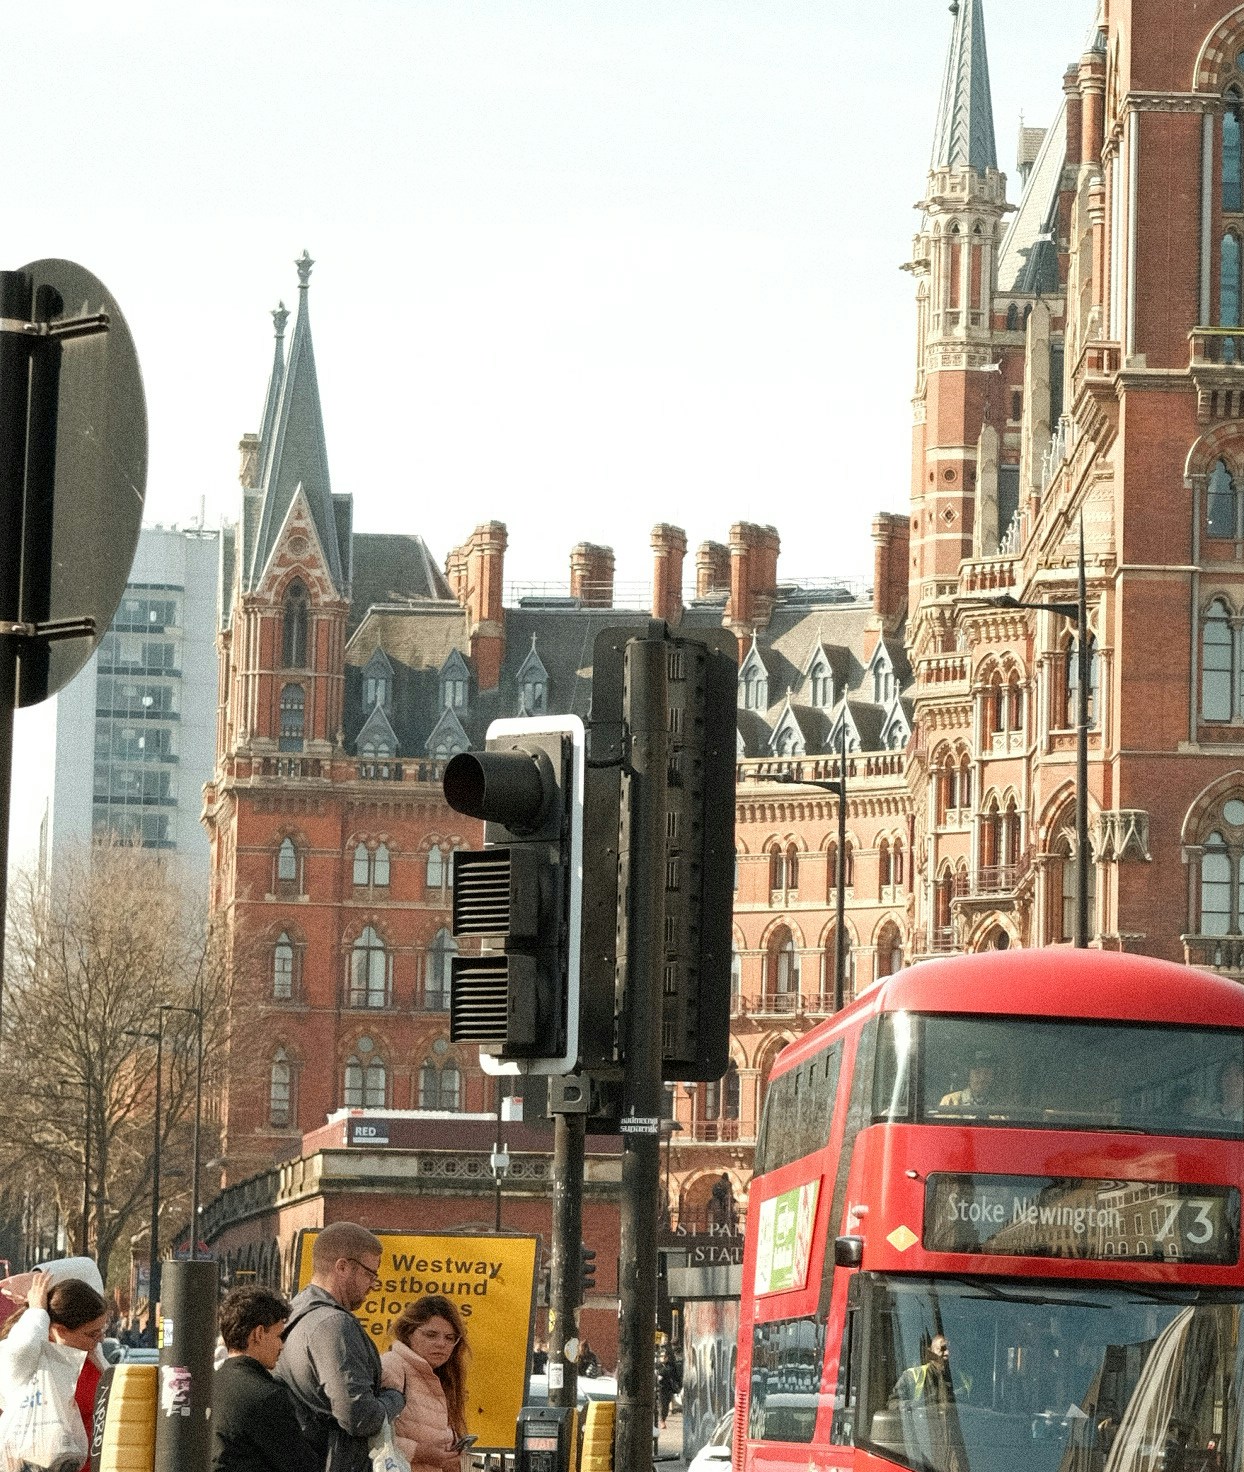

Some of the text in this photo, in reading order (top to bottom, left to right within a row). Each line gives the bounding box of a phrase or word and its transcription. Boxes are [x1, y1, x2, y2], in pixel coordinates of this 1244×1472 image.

[355, 1126, 377, 1137] RED
[948, 1192, 1214, 1244] Stoke Newington 73
[695, 1246, 743, 1262] STAT
[392, 1254, 503, 1279] Westway
[372, 1276, 489, 1296] estbound
